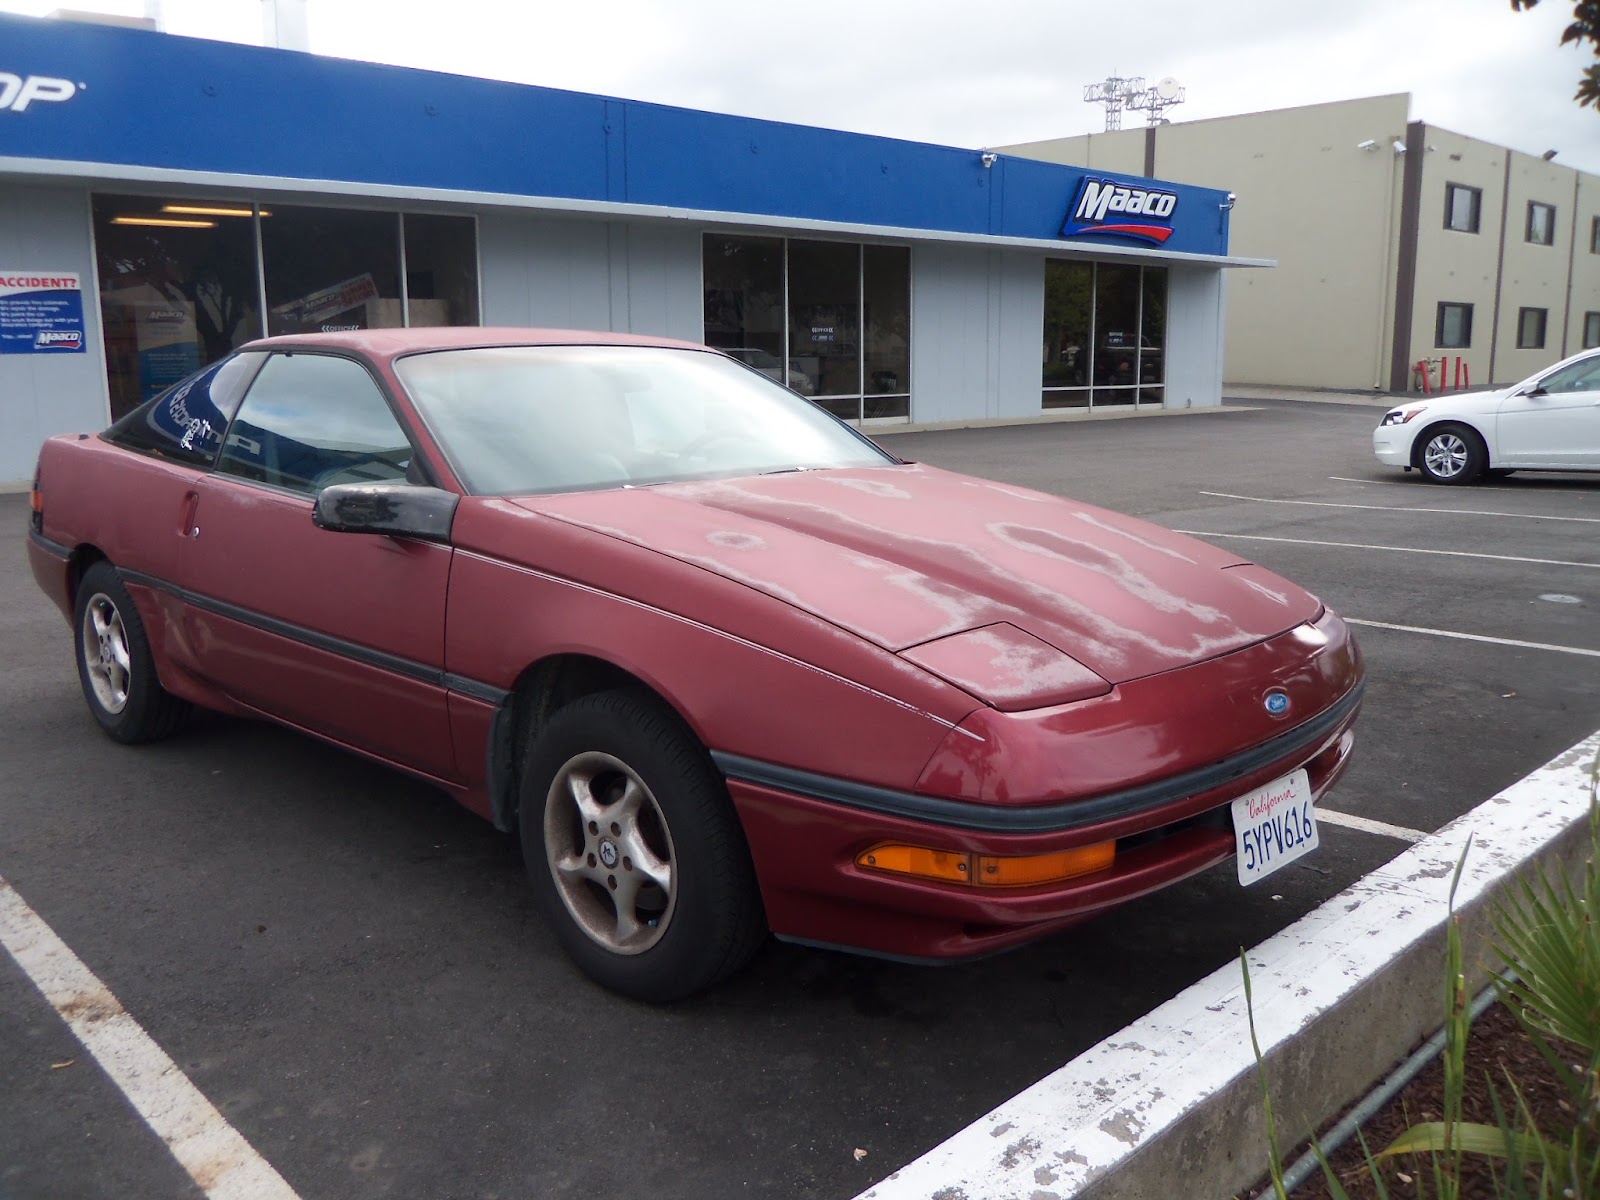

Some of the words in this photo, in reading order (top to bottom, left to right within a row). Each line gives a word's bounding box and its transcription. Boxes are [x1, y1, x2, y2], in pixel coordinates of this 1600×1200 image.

[1075, 182, 1176, 220] Maaco
[0, 278, 77, 288] ACCIDENT?
[37, 332, 79, 344] Maaco
[1249, 789, 1297, 818] California
[1242, 801, 1312, 870] 5YPV616
